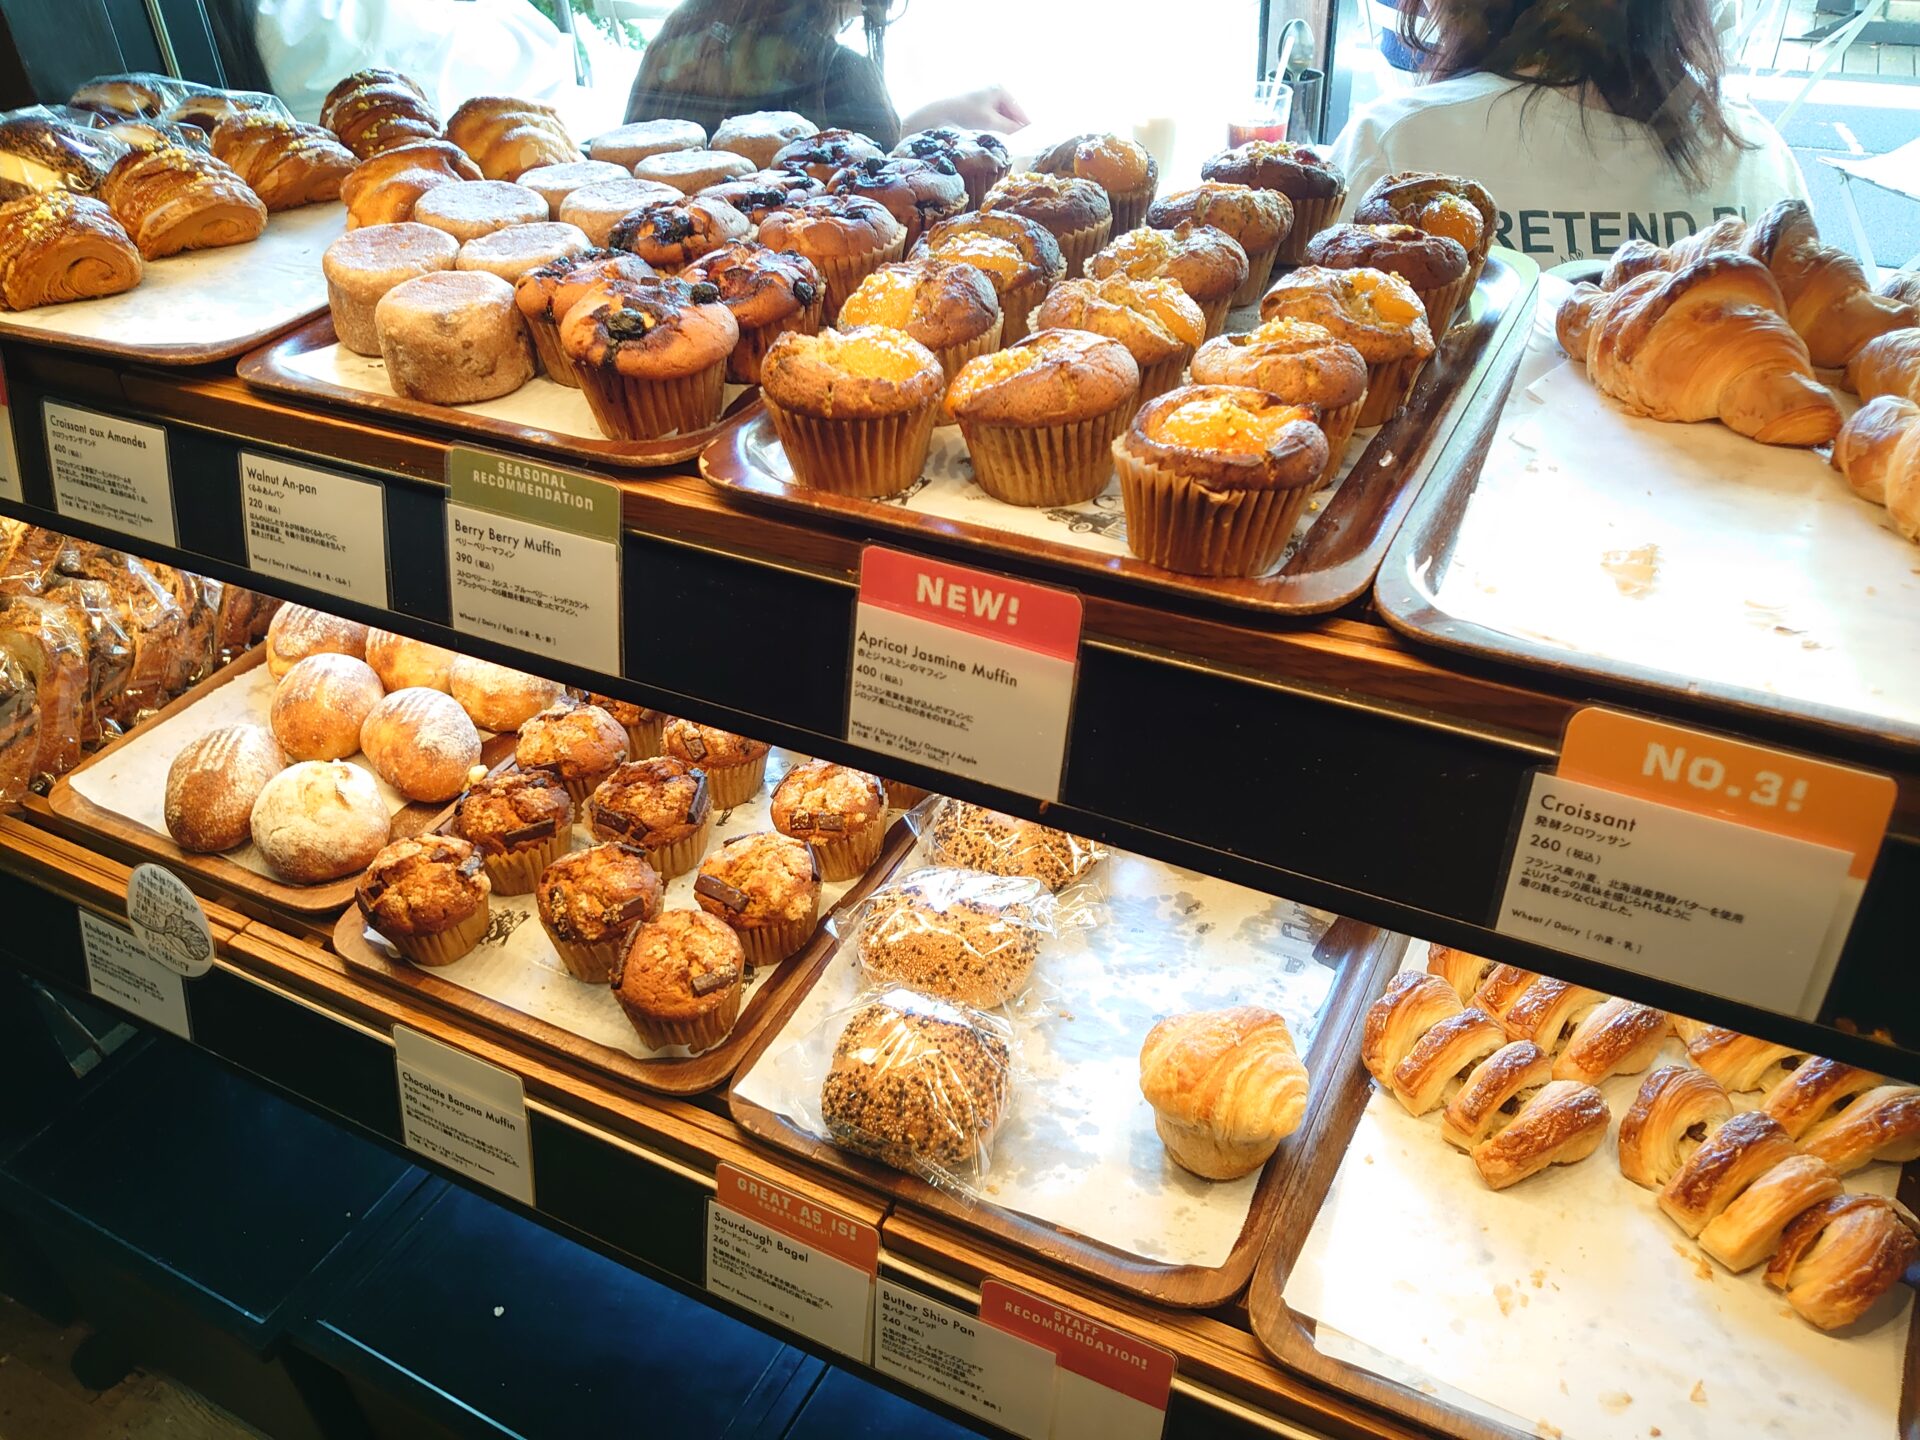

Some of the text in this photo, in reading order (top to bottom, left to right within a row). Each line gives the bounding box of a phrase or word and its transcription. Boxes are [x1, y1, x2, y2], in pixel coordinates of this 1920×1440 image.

[49, 414, 146, 449] Croissant aux Amandes
[53, 443, 66, 454] 400
[246, 466, 317, 498] Walnut An-pan
[247, 483, 284, 500] くるみあんパン
[473, 470, 594, 511] RECOMMENDATION
[498, 461, 566, 489] SEASONAL
[248, 496, 262, 509] 220
[454, 518, 561, 558] Berry Berry Muffin
[455, 535, 515, 560] ベリーベリーマフィン
[455, 551, 472, 565] 390
[916, 573, 1020, 626] NEW!
[856, 662, 877, 678] 400
[857, 647, 947, 681] 杏とジャスミンのマフィン
[858, 629, 1018, 688] Apricot Jasmine Muffin
[852, 720, 872, 732] Wheat
[879, 728, 897, 741] Dairy
[904, 735, 917, 747] Egg
[924, 742, 949, 757] Orange
[956, 752, 977, 765] Apple
[1641, 742, 1809, 814] NO.3!
[1539, 793, 1638, 833] Croissant
[1529, 833, 1561, 853] 260
[1534, 814, 1632, 850] 発酵クロワッサン
[1520, 866, 1692, 921] よりバターの風味を感じられるように
[1510, 908, 1543, 924] Wheat
[1553, 920, 1581, 937] Dairy
[402, 1071, 515, 1132] Chocolate Banana Muffin
[737, 1177, 857, 1241] GREAT AS IS!
[713, 1234, 729, 1248] 260
[714, 1211, 808, 1265] Sourdough Bagel
[883, 1290, 975, 1338] Butter Shio Pan
[883, 1312, 900, 1327] 240
[1053, 1311, 1101, 1338] STAFF
[1004, 1302, 1148, 1371] RECOMMENDATION!
